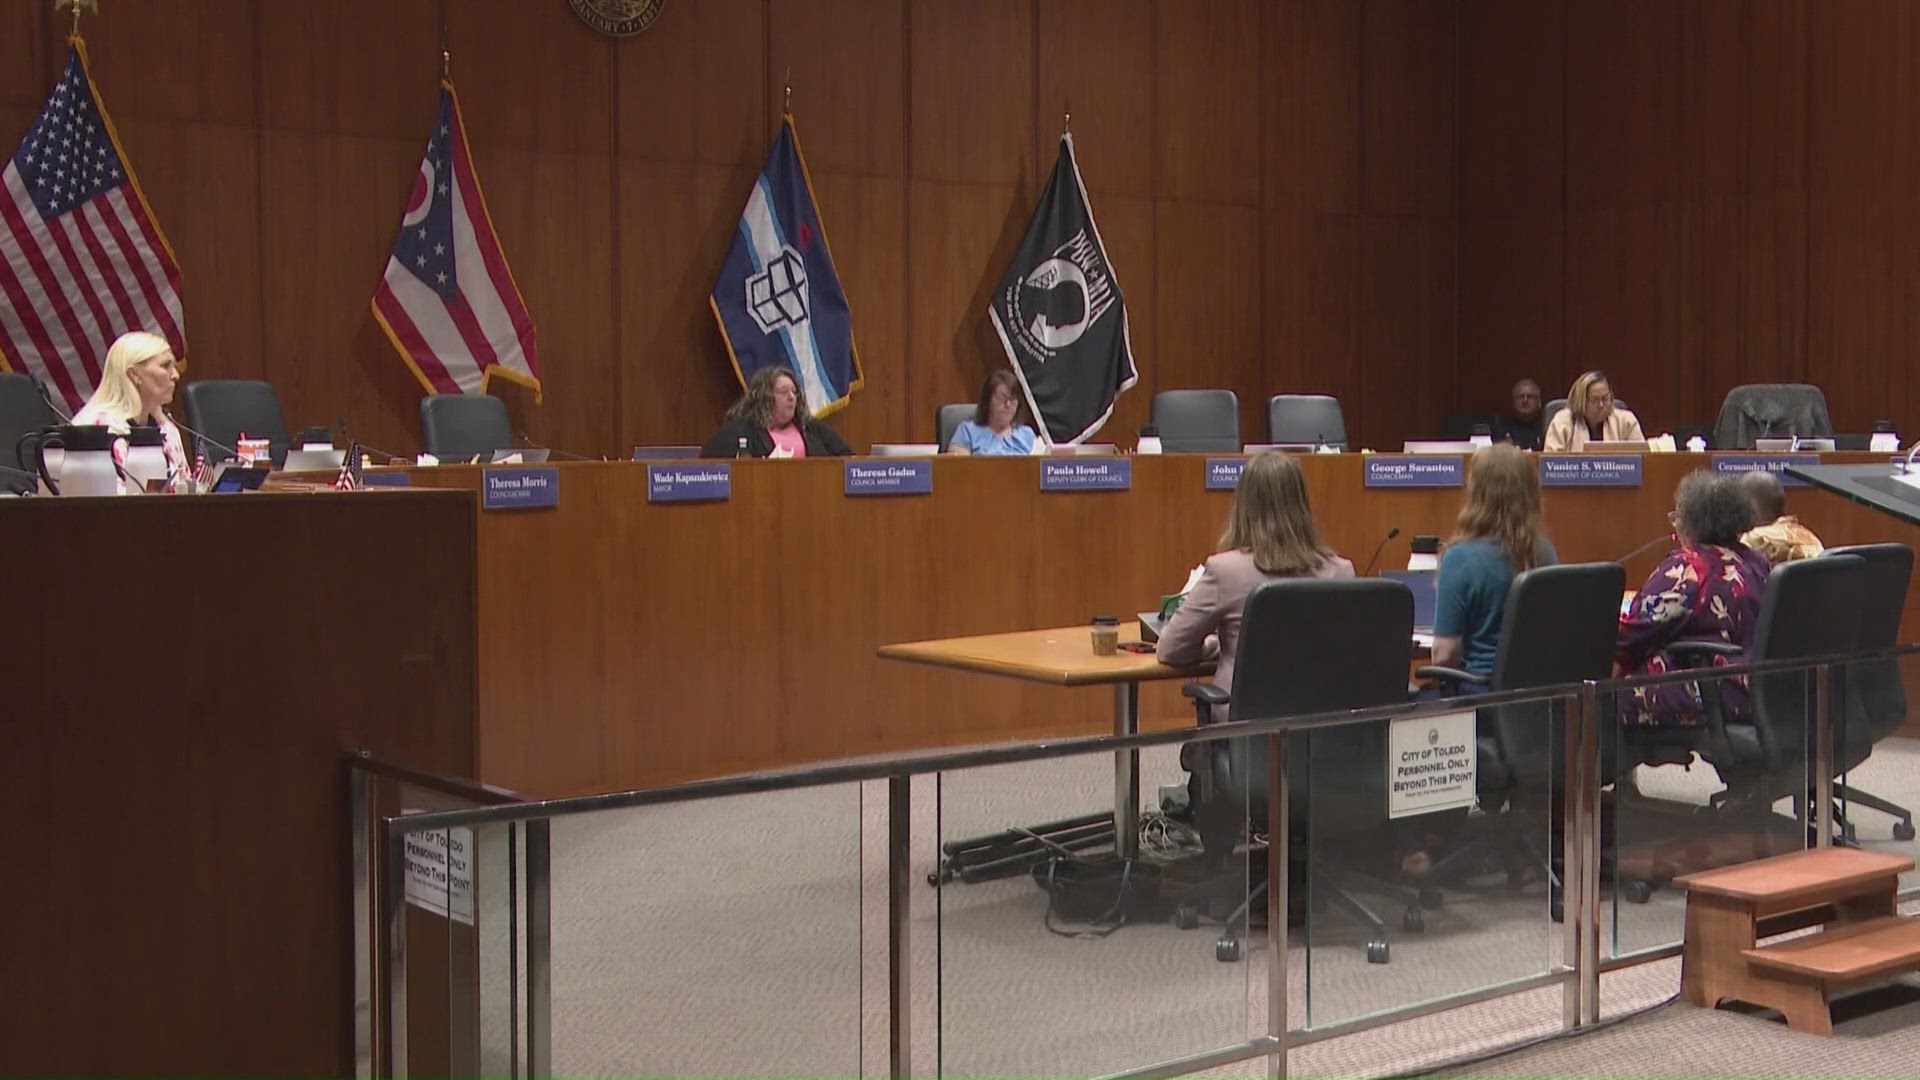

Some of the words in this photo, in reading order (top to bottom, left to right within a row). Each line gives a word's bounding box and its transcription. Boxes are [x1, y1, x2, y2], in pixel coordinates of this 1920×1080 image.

[1047, 465, 1074, 475] Paula
[1076, 465, 1108, 475] Howell
[1212, 465, 1237, 474] John
[1371, 463, 1407, 473] George
[1409, 463, 1455, 472] Sarantou
[1545, 461, 1579, 472] Vanice
[1581, 461, 1591, 471] S.
[1593, 461, 1636, 471] Williams
[1718, 461, 1766, 471] Cerssandra
[1768, 461, 1789, 472] McP
[653, 472, 675, 483] Wade
[851, 468, 887, 478] Theresa
[888, 467, 916, 477] Gadus
[489, 478, 521, 489] Theresa
[522, 476, 548, 488] Morris
[653, 485, 672, 493] MAYOR
[1401, 751, 1420, 762] CITY
[1421, 750, 1432, 759] OF
[1433, 745, 1466, 758] TOLEDO
[1397, 764, 1446, 777] PERSONNEL
[1447, 758, 1470, 770] ONLY
[1393, 779, 1427, 792] BEYOND
[1428, 775, 1448, 787] THIS
[1449, 772, 1473, 784] POINT
[407, 842, 446, 865] PERSONNEL
[432, 866, 446, 883] THIS
